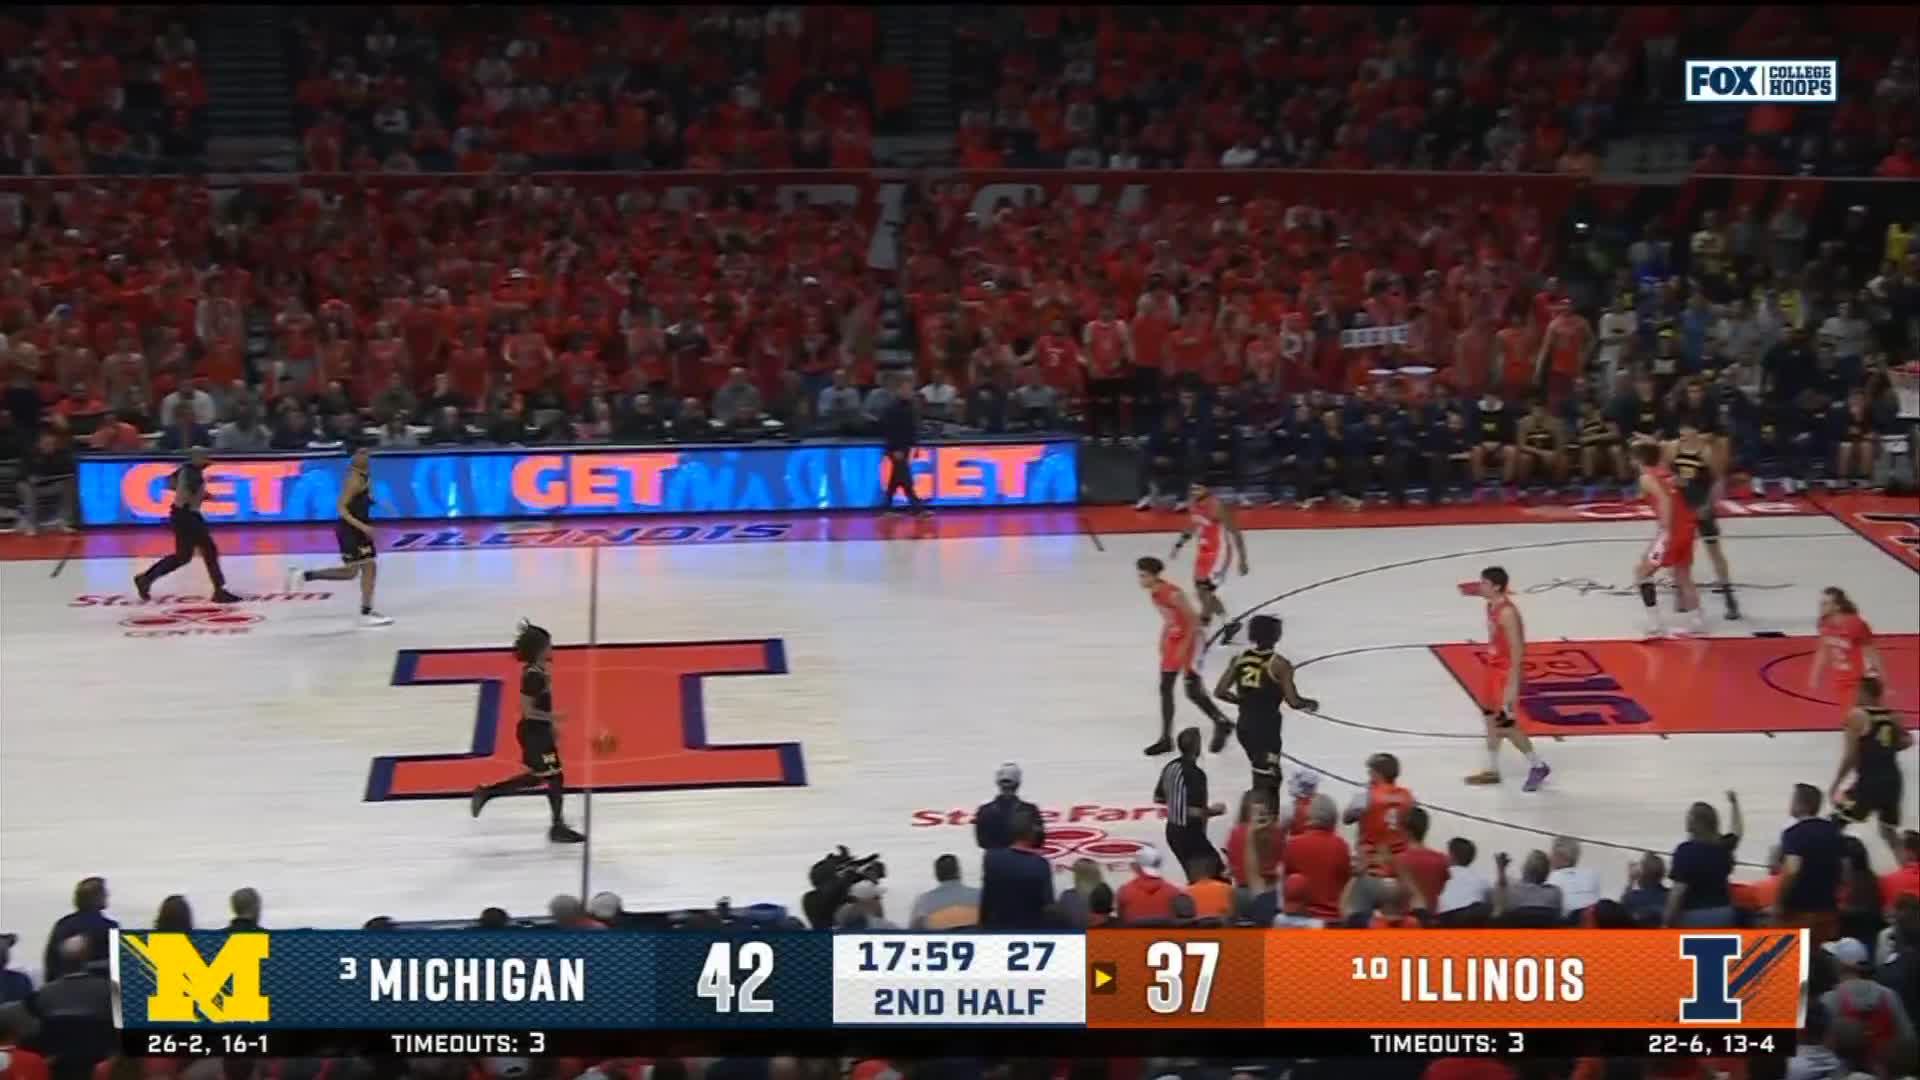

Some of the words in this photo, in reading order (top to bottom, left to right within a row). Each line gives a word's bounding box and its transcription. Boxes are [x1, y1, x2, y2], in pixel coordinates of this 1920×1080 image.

[120, 460, 303, 518] GET
[511, 452, 680, 509] GET
[392, 524, 792, 548] ILLINOIS
[1240, 664, 1262, 688] 21
